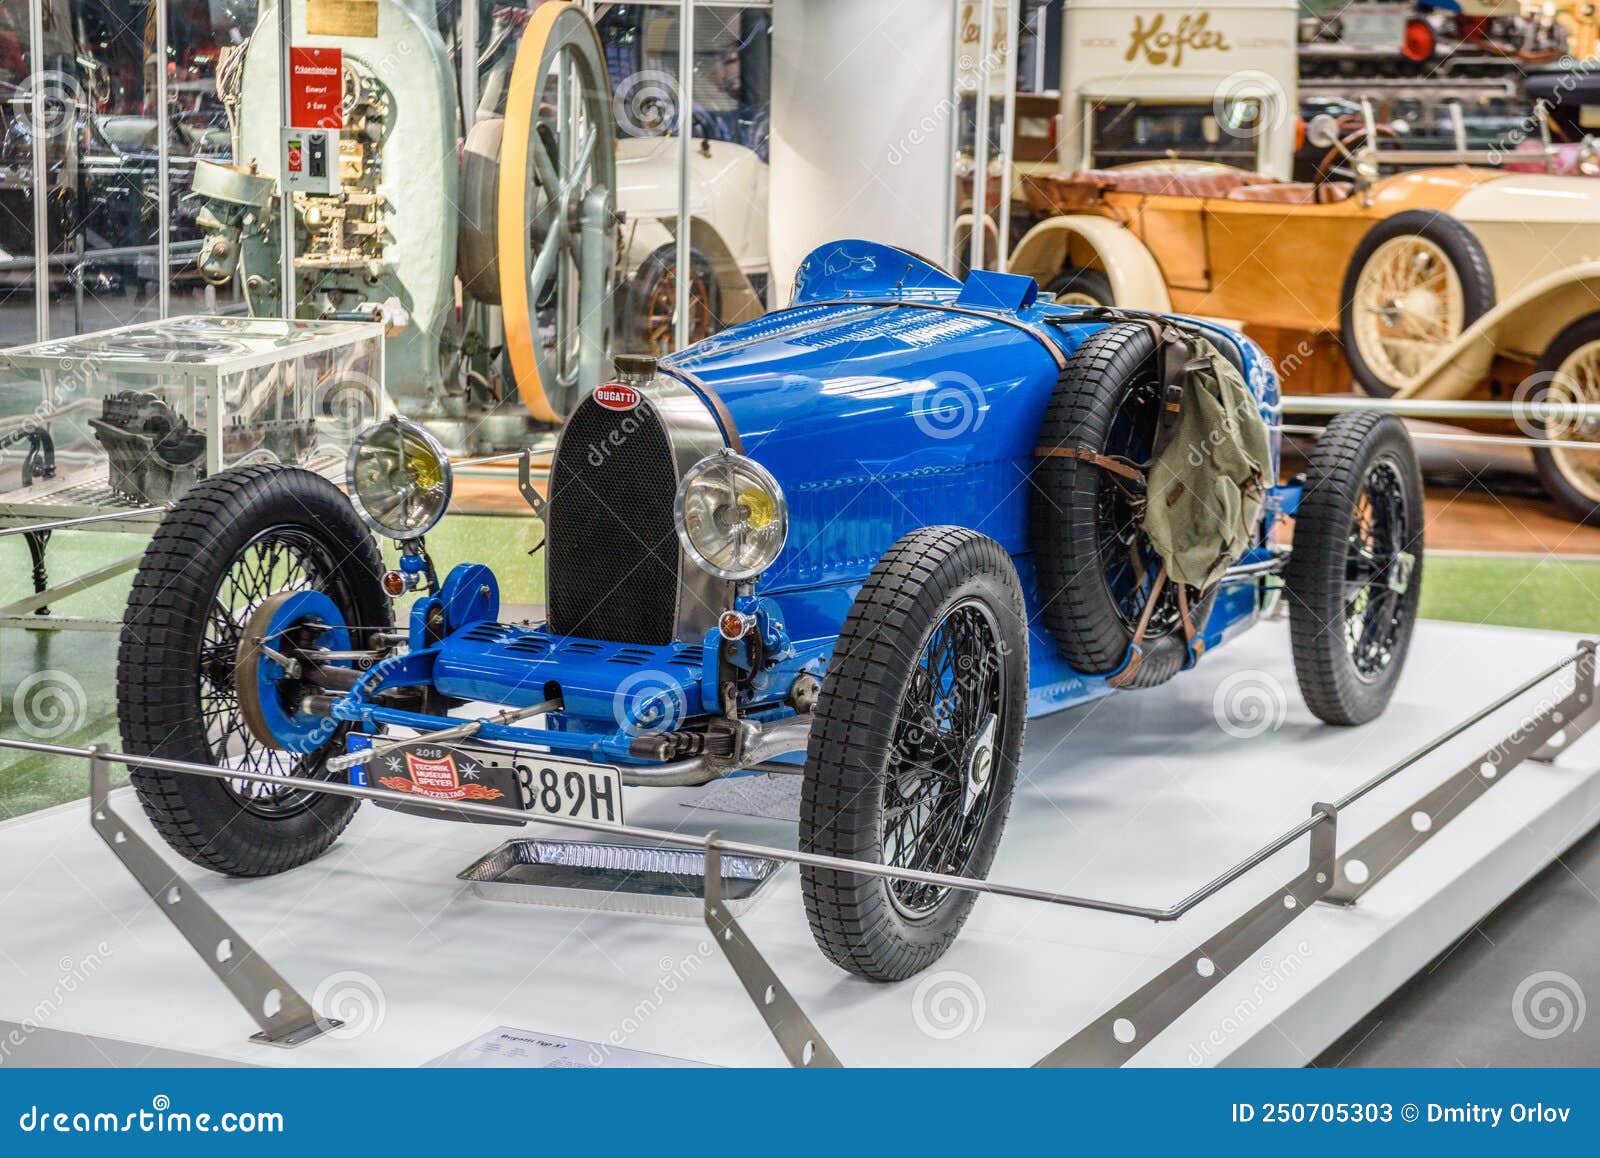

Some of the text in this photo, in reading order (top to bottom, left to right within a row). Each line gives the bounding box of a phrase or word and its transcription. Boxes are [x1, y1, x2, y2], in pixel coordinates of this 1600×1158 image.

[1124, 12, 1231, 68] Kofler
[597, 390, 635, 403] BUGATTI
[415, 747, 442, 758] 2018
[414, 763, 450, 772] TECHNIK
[415, 770, 452, 779] MUSEUM
[417, 778, 454, 787] SPEYER
